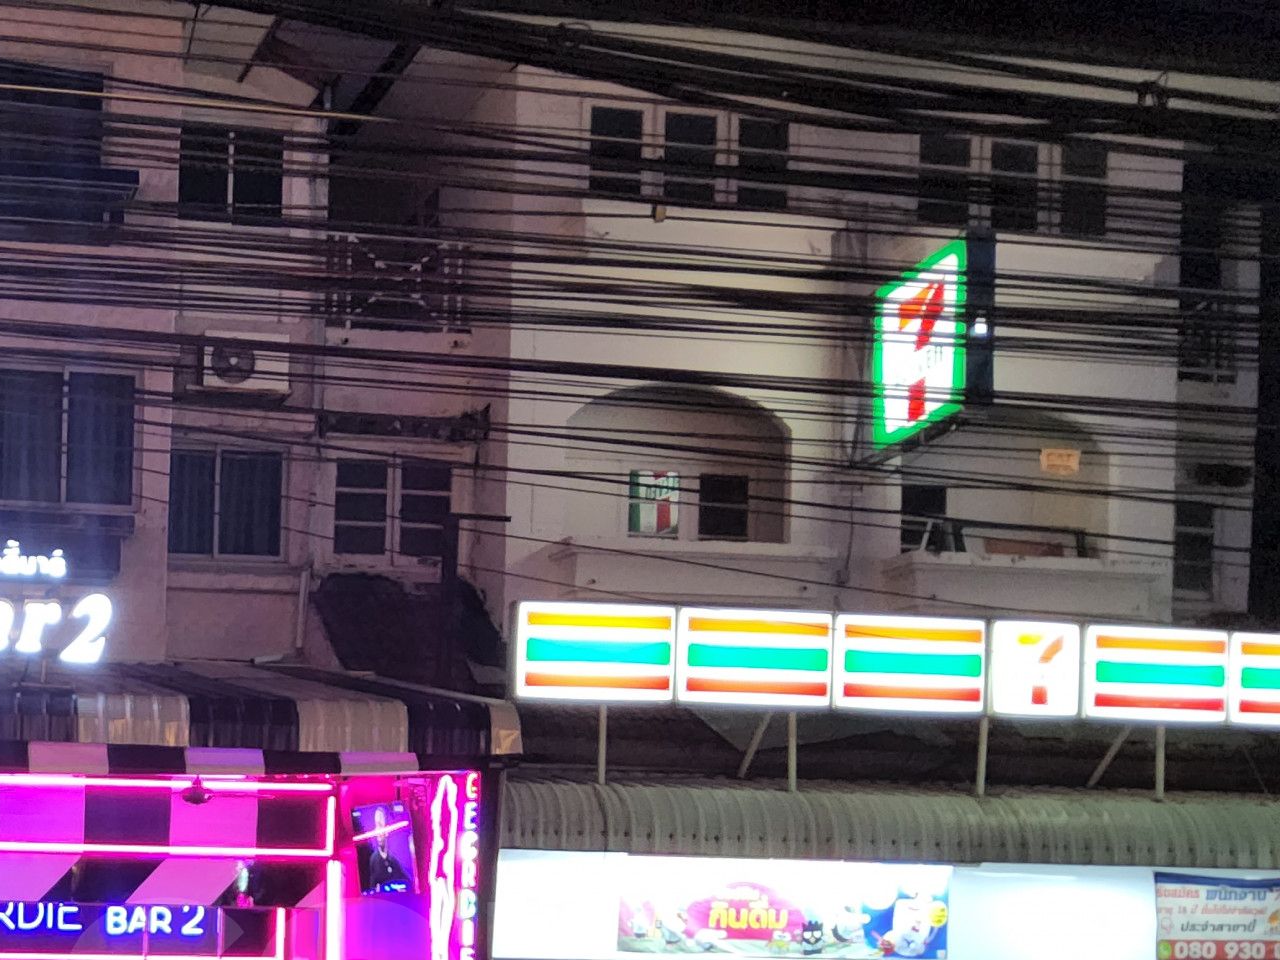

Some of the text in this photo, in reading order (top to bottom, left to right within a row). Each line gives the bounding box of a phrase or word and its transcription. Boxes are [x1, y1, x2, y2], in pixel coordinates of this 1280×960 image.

[59, 593, 113, 664] 2
[105, 905, 173, 935] BAR
[180, 905, 207, 936] 2
[1174, 941, 1217, 960] 080
[1223, 941, 1266, 960] 930
